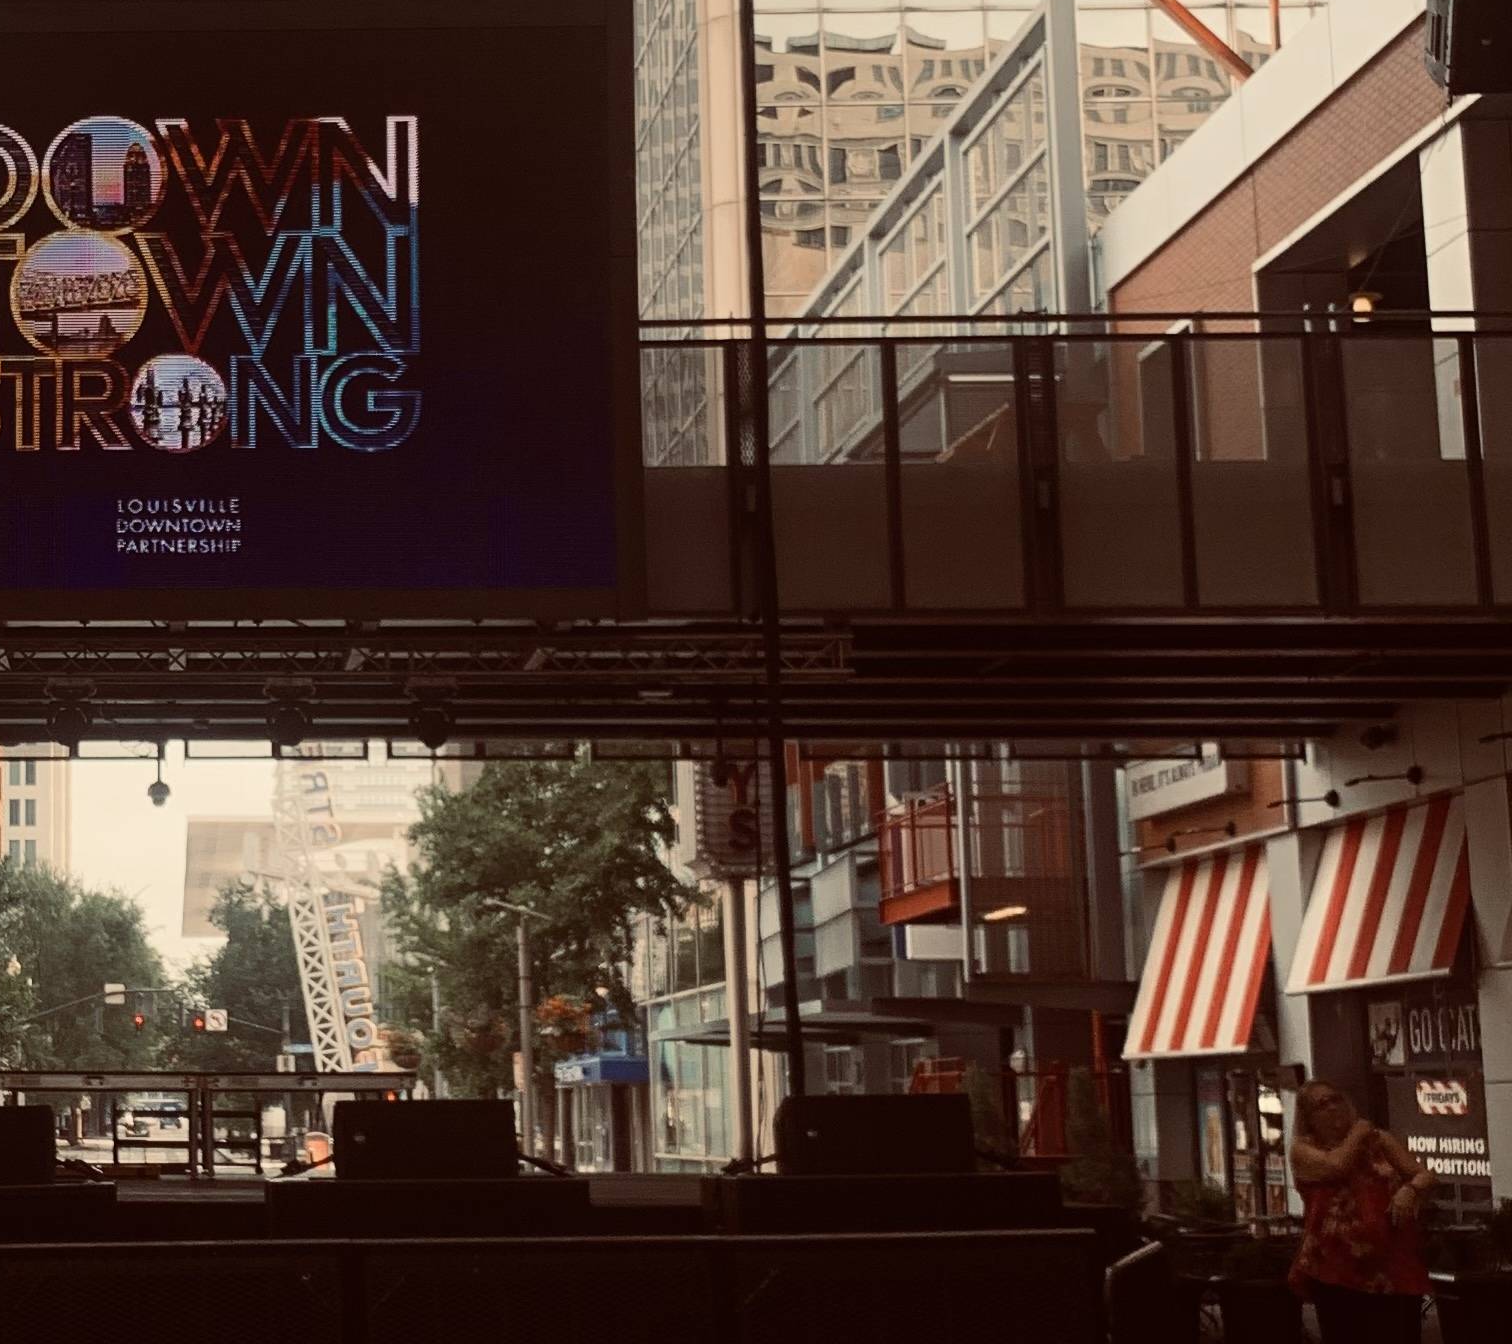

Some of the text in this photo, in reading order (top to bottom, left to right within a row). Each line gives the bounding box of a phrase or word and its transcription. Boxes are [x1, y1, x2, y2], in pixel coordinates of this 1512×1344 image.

[117, 498, 240, 514] LOUISVILLE
[116, 518, 242, 533] DOWNTOWN
[116, 538, 242, 554] PARTNERSHIP
[1409, 1005, 1477, 1054] GO CAT
[1408, 1136, 1485, 1155] NOW HIRING
